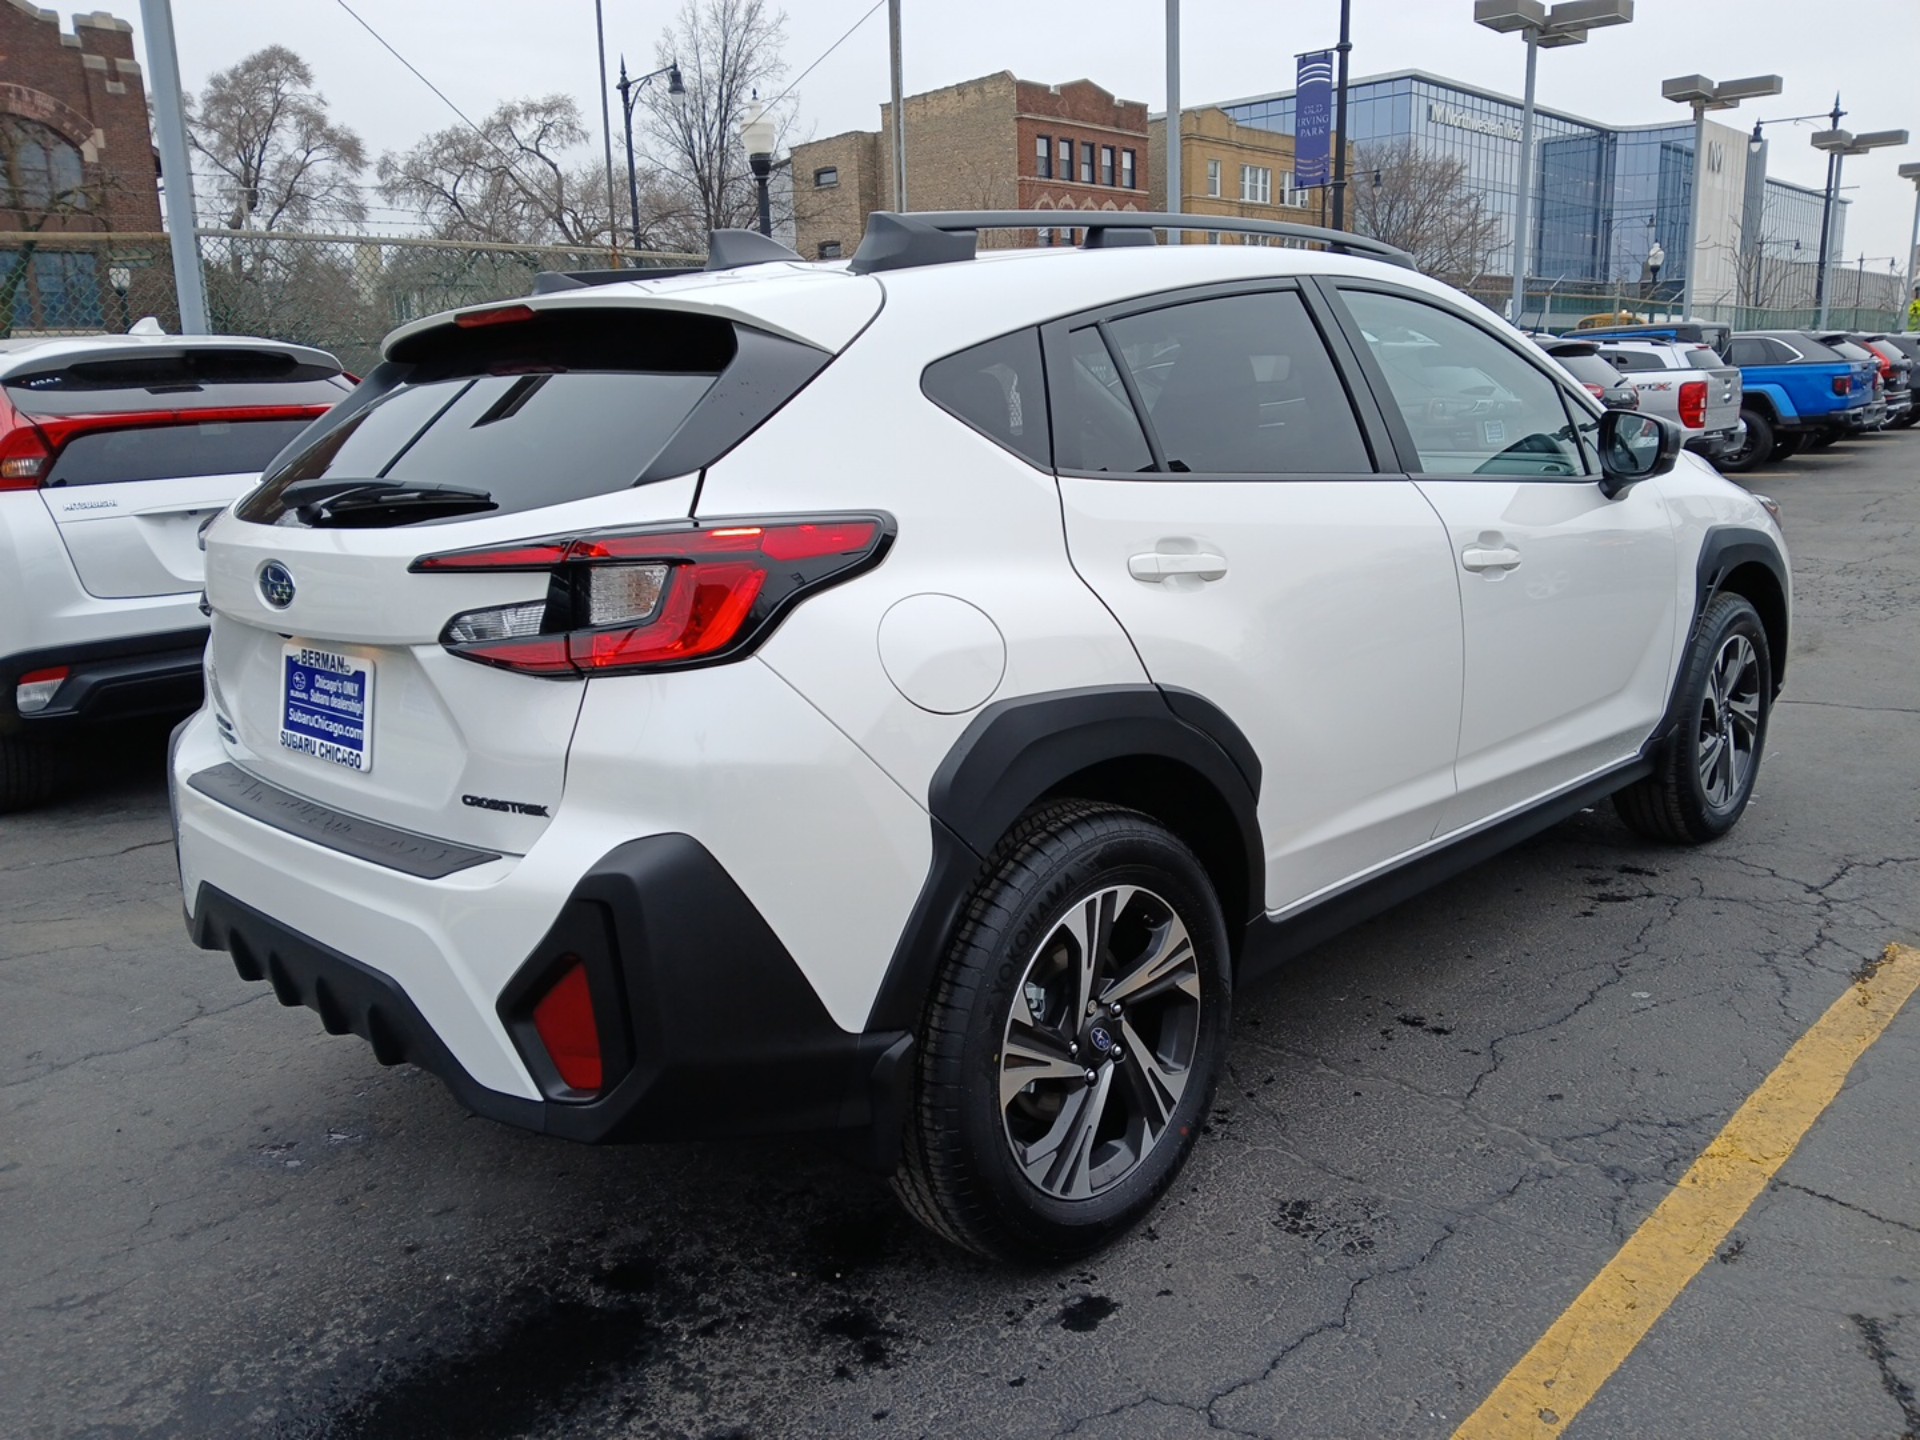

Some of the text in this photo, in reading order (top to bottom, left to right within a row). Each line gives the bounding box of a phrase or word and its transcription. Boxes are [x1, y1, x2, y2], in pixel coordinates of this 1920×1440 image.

[1297, 114, 1329, 127] IRVING
[1303, 103, 1324, 115] OLD
[1300, 126, 1325, 137] PARK
[1446, 107, 1505, 136] Northwestern
[63, 500, 118, 511] MITSUBISHI
[301, 649, 345, 673] BERMAN
[314, 674, 360, 696] Chicago's ONLY
[310, 689, 364, 716] Subaru dealership!
[288, 707, 364, 741] SubaruChicago.com
[280, 730, 362, 769] SUBARU CHICAGO
[462, 794, 550, 818] CROSSTREK
[991, 873, 1074, 995] YOKOHAMA
